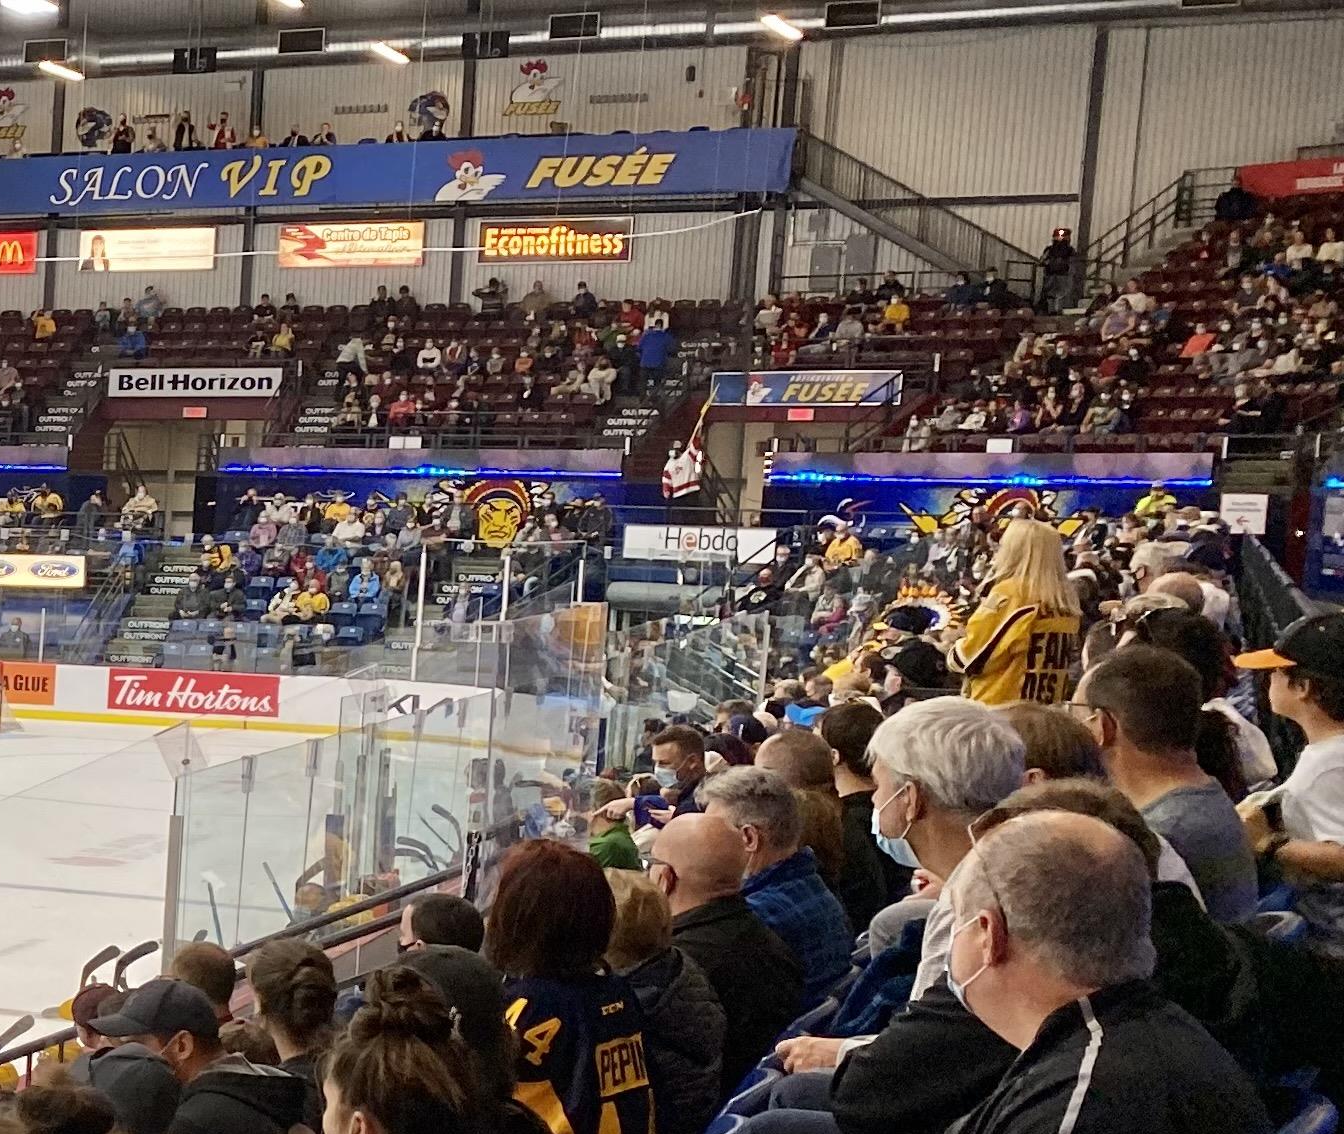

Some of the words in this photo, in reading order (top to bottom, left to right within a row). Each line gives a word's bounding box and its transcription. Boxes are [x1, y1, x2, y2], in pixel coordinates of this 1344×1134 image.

[50, 161, 209, 207] SALON
[221, 154, 333, 198] VIP
[525, 145, 677, 190] FUSÉE
[322, 228, 363, 242] Centre
[364, 227, 378, 241] de
[379, 227, 410, 242] Tapis
[485, 225, 624, 257] Econofitness
[665, 527, 739, 551] Hebdo
[38, 563, 71, 578] Ford
[13, 674, 49, 692] GLUE
[114, 676, 163, 707] Tim
[167, 676, 273, 712] Hortons
